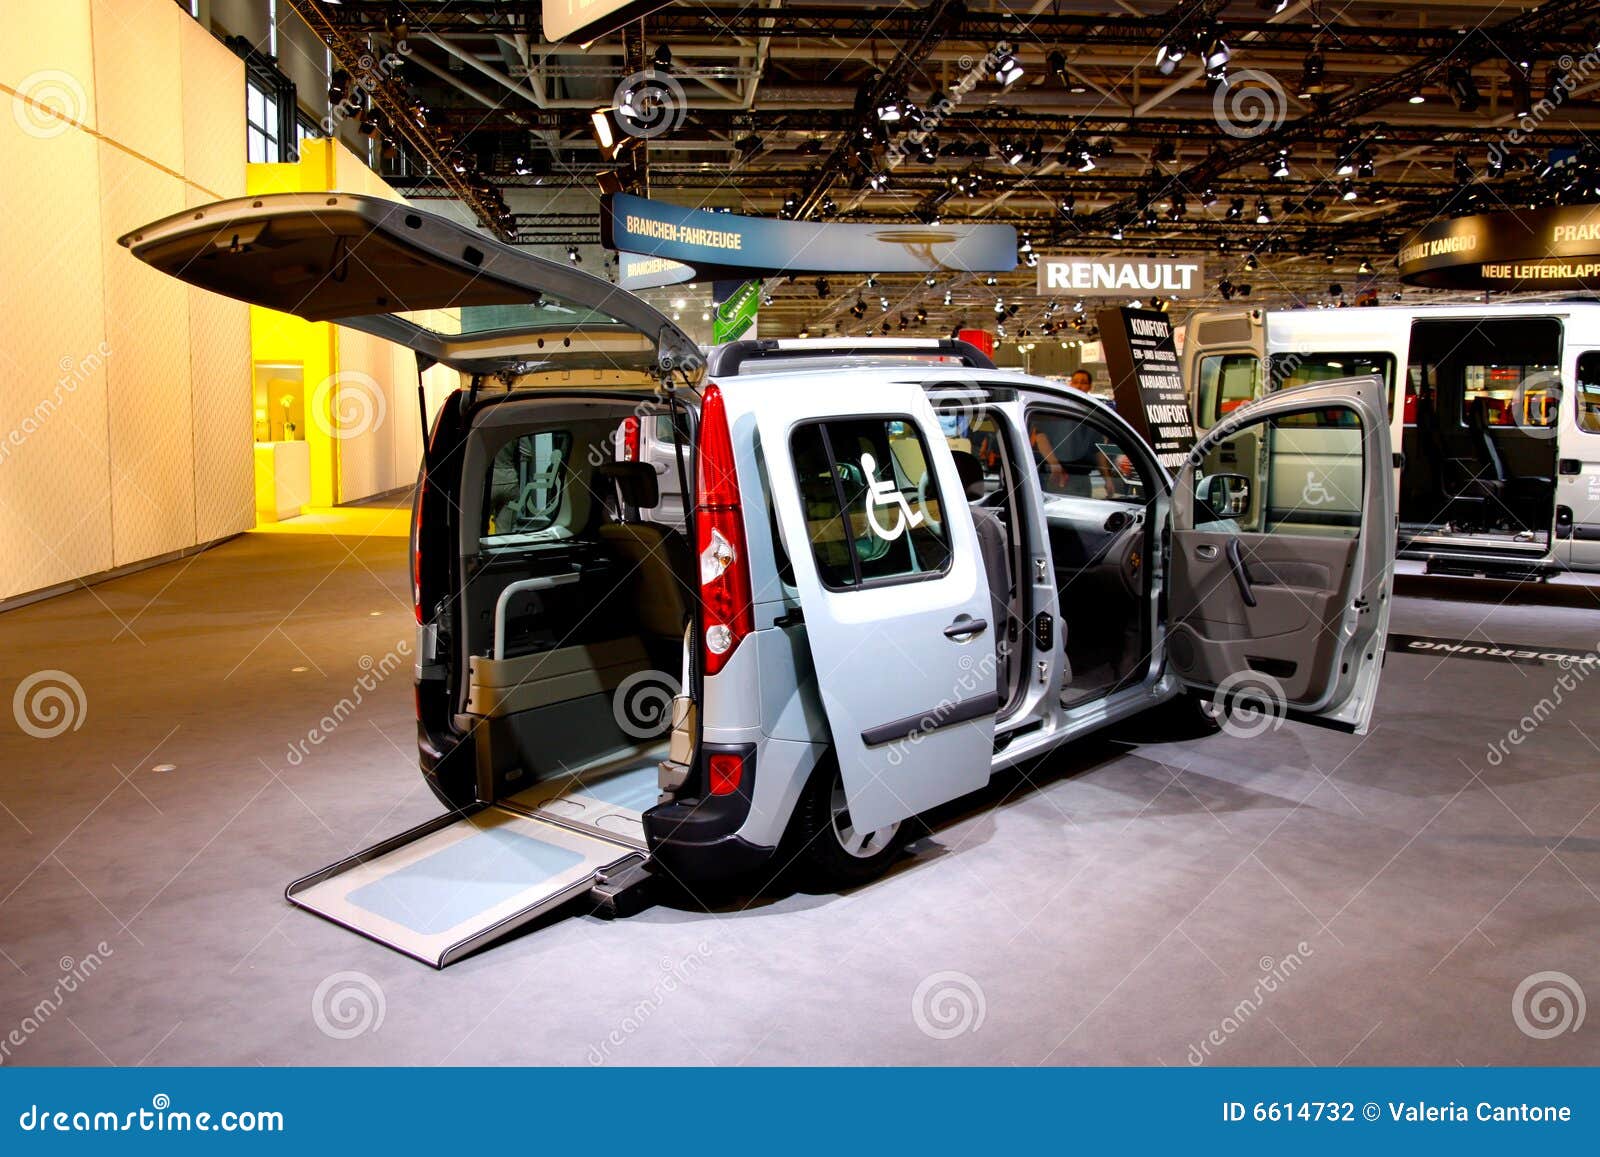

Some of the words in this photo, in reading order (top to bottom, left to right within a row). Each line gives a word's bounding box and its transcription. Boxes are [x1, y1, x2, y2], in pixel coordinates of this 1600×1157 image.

[626, 216, 742, 249] BRANCHEN-FAHRZEUGE
[1430, 235, 1477, 256] KANGOO
[1046, 262, 1198, 290] RENAULT
[1481, 264, 1512, 279] NEUE
[1130, 318, 1170, 338] KOMFORT
[1139, 373, 1182, 390] VARIABILITÄT
[1146, 404, 1189, 424] KOMFORT
